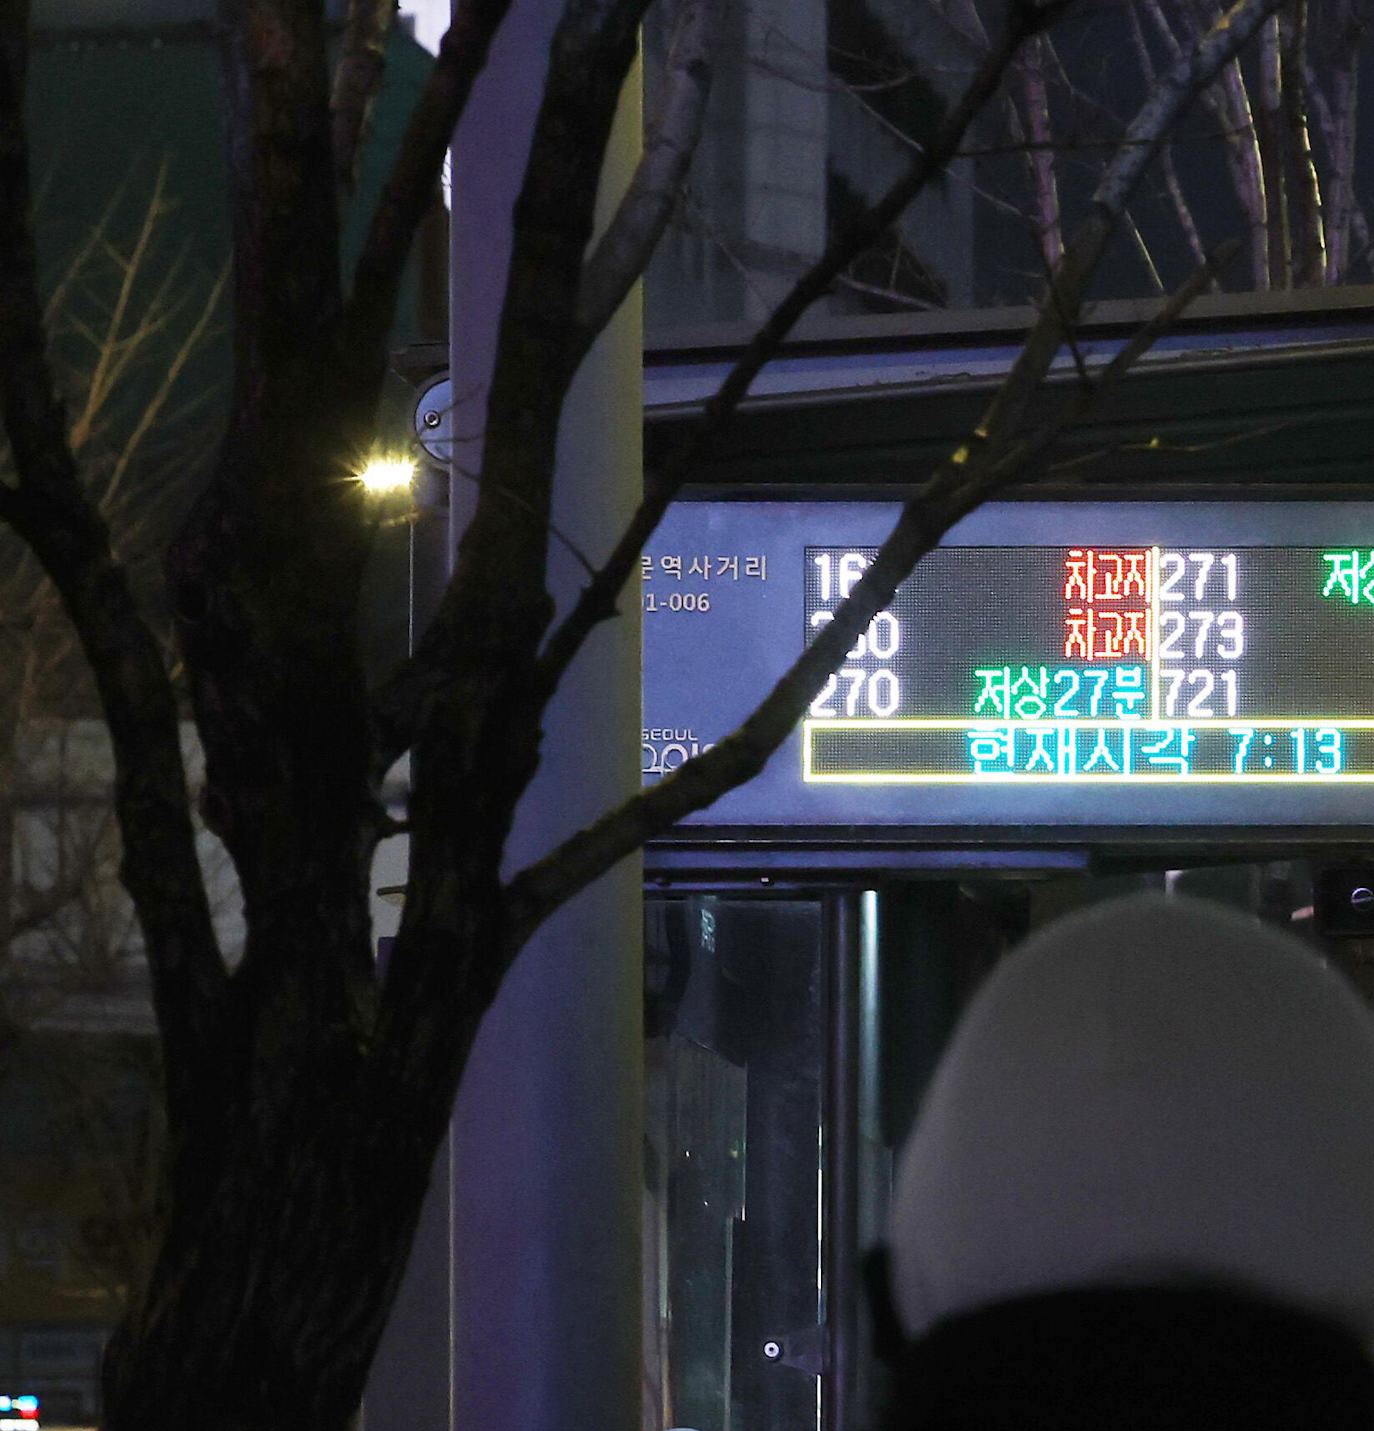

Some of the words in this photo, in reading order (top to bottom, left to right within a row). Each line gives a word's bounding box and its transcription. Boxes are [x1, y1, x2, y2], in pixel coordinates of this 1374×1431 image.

[1065, 550, 1152, 602] 차고지
[1159, 553, 1237, 601] 271
[641, 593, 711, 612] 1-006
[1065, 608, 1152, 660] 차고지
[1159, 611, 1244, 659] 273
[810, 668, 900, 717] 270
[1159, 669, 1237, 718] 721
[641, 728, 699, 740] SEOUL
[967, 727, 1196, 775] 현재시각
[1228, 727, 1343, 774] 7:13
